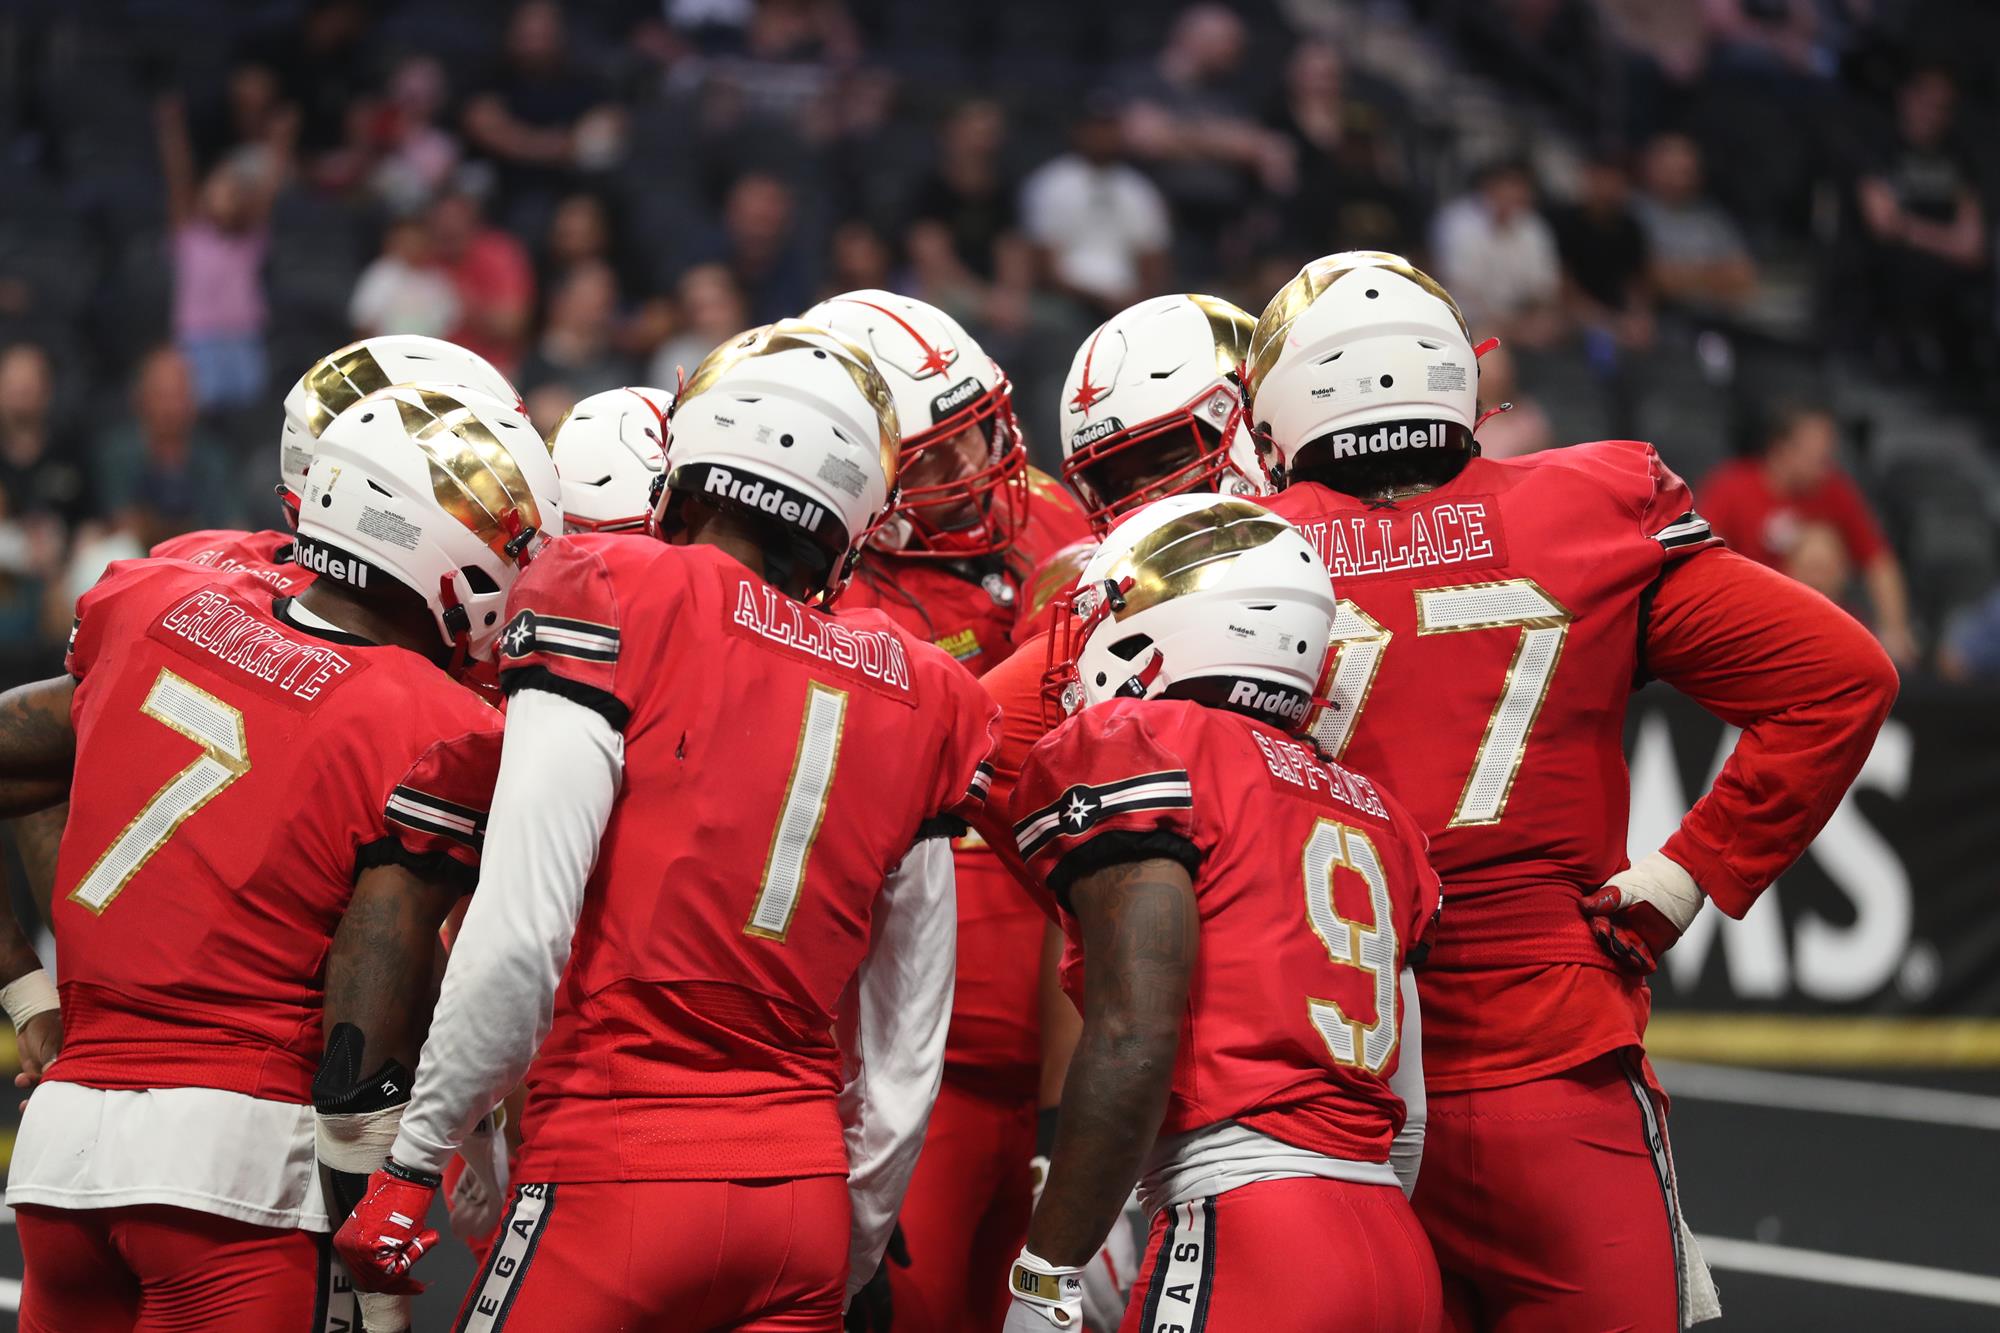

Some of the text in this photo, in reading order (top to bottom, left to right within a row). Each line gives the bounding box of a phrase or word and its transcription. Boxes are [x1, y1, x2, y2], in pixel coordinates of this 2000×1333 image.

[936, 379, 981, 412] Riddell
[1073, 419, 1114, 448] Riddell
[1332, 423, 1446, 460] Riddell
[704, 466, 824, 532] Riddell
[292, 538, 368, 589] Riddell
[162, 590, 352, 701] CRONKRITE
[733, 580, 909, 691] ALLISON
[65, 665, 252, 918] 7
[742, 678, 849, 945] 1
[1302, 816, 1400, 1076] 9
[381, 1079, 399, 1097] KT
